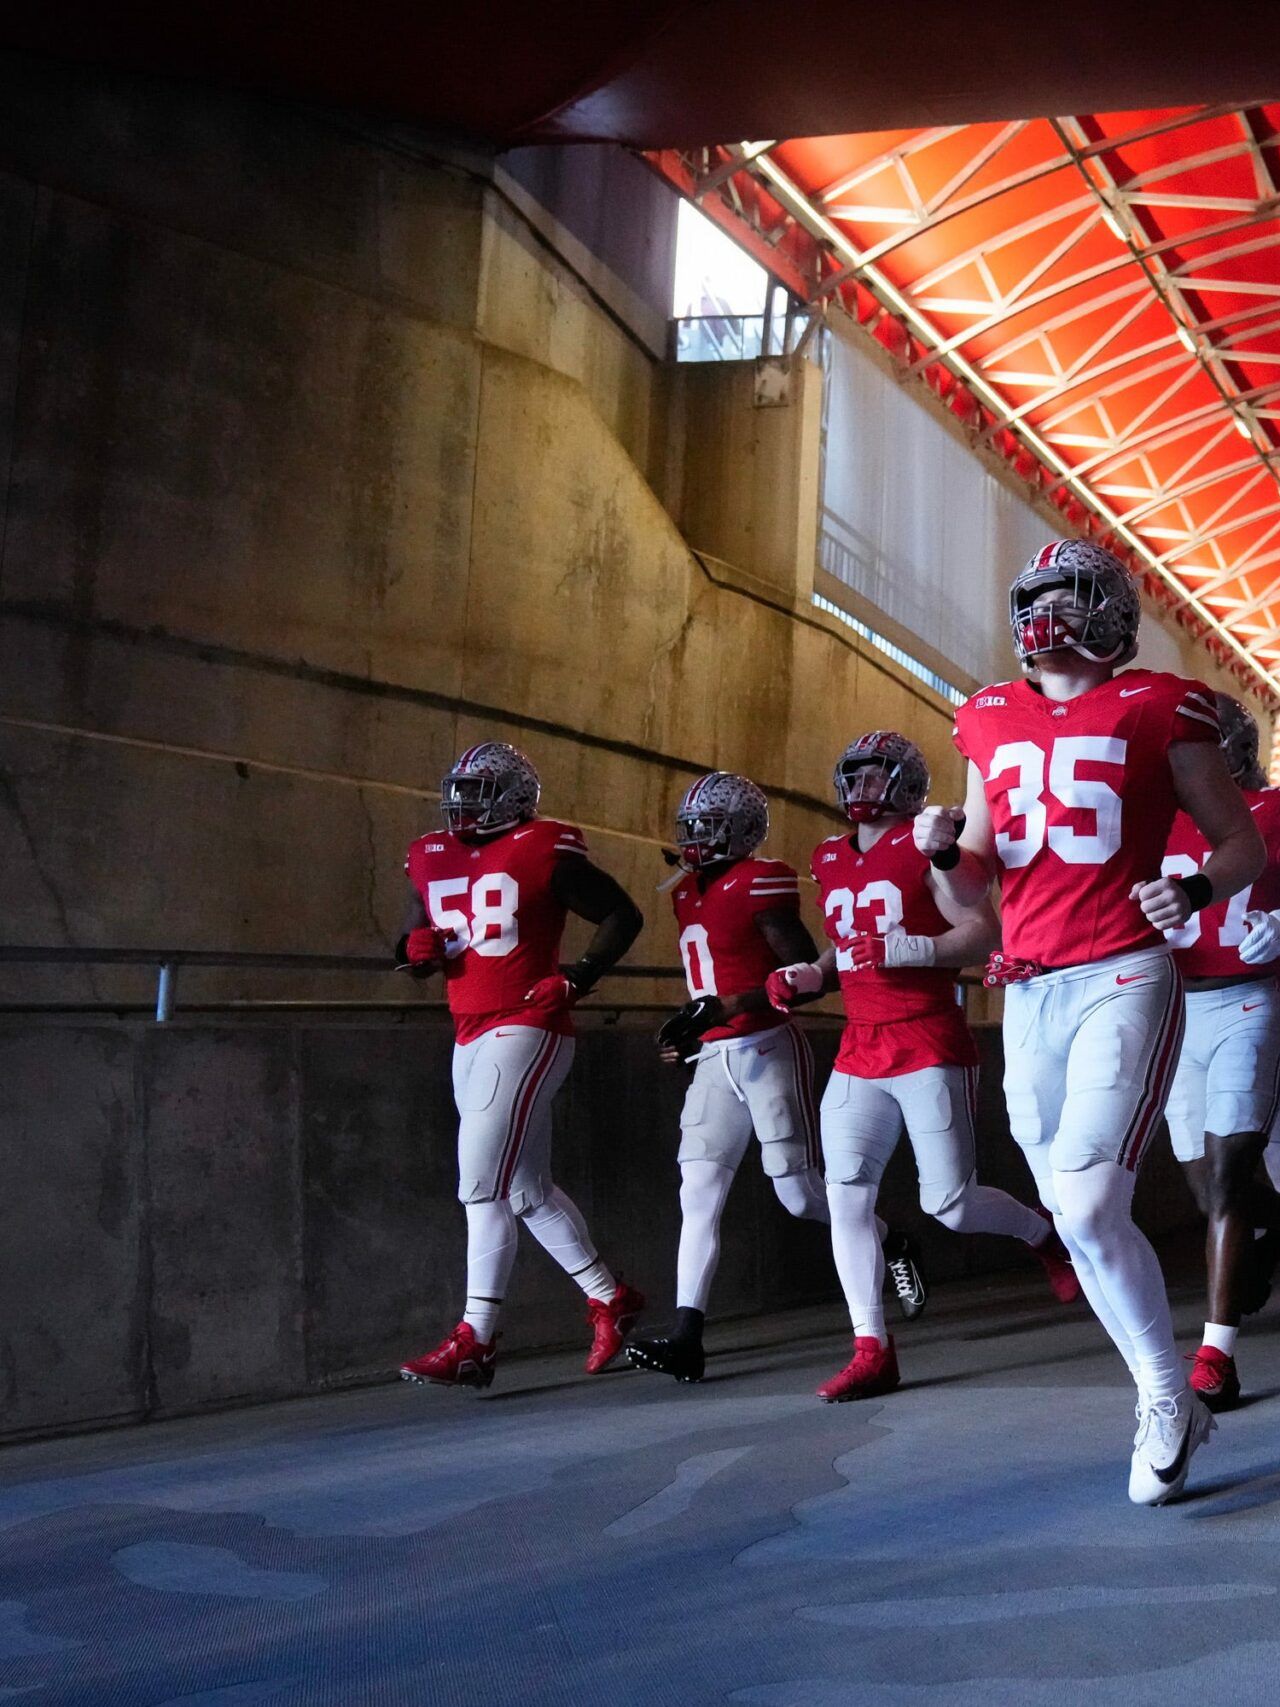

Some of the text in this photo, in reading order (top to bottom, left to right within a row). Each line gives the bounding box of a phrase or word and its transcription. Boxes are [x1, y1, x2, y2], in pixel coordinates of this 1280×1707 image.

[984, 735, 1127, 869] 35
[428, 872, 519, 957] 58
[679, 923, 718, 1001] 0
